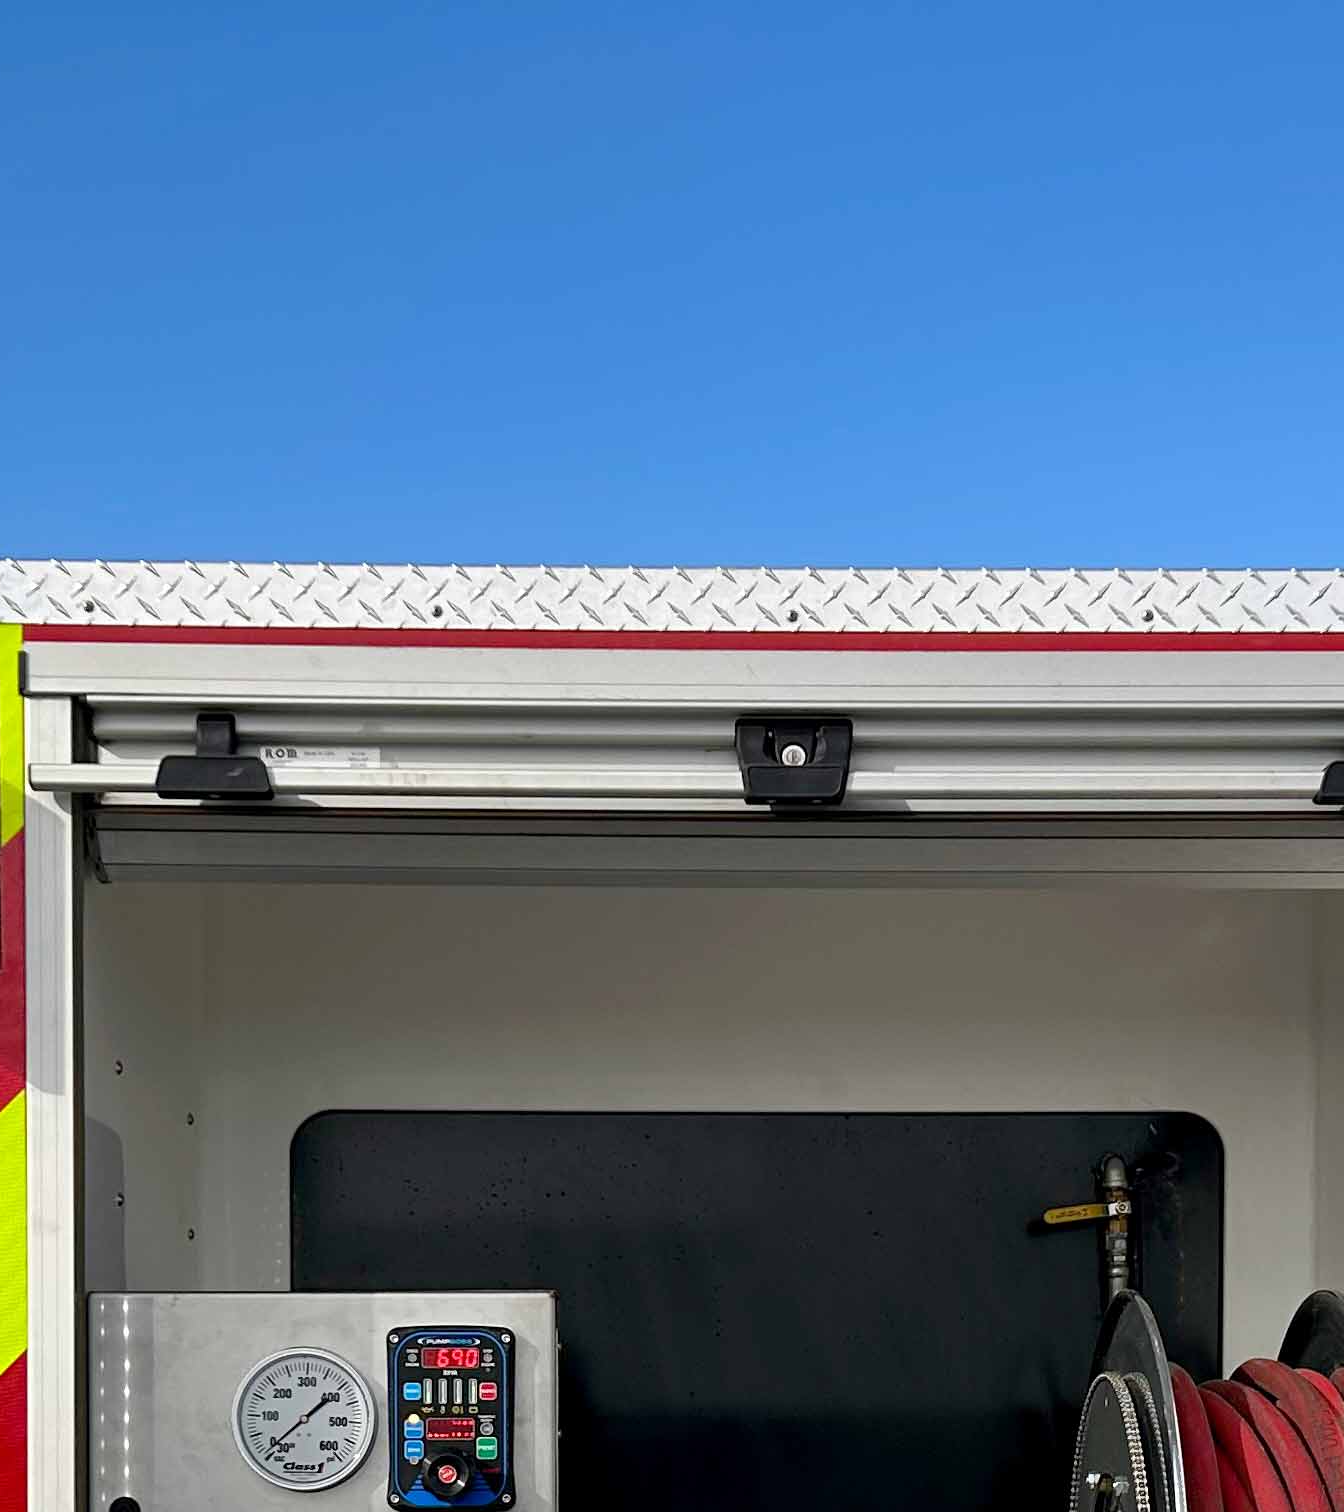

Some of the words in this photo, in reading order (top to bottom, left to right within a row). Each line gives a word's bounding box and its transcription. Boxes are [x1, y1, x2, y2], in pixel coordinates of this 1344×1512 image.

[437, 1348, 477, 1368] 690
[297, 1377, 317, 1387] 300
[273, 1388, 292, 1399] 200
[261, 1410, 279, 1421] 100
[328, 1416, 348, 1427] 500
[319, 1440, 338, 1451] 600
